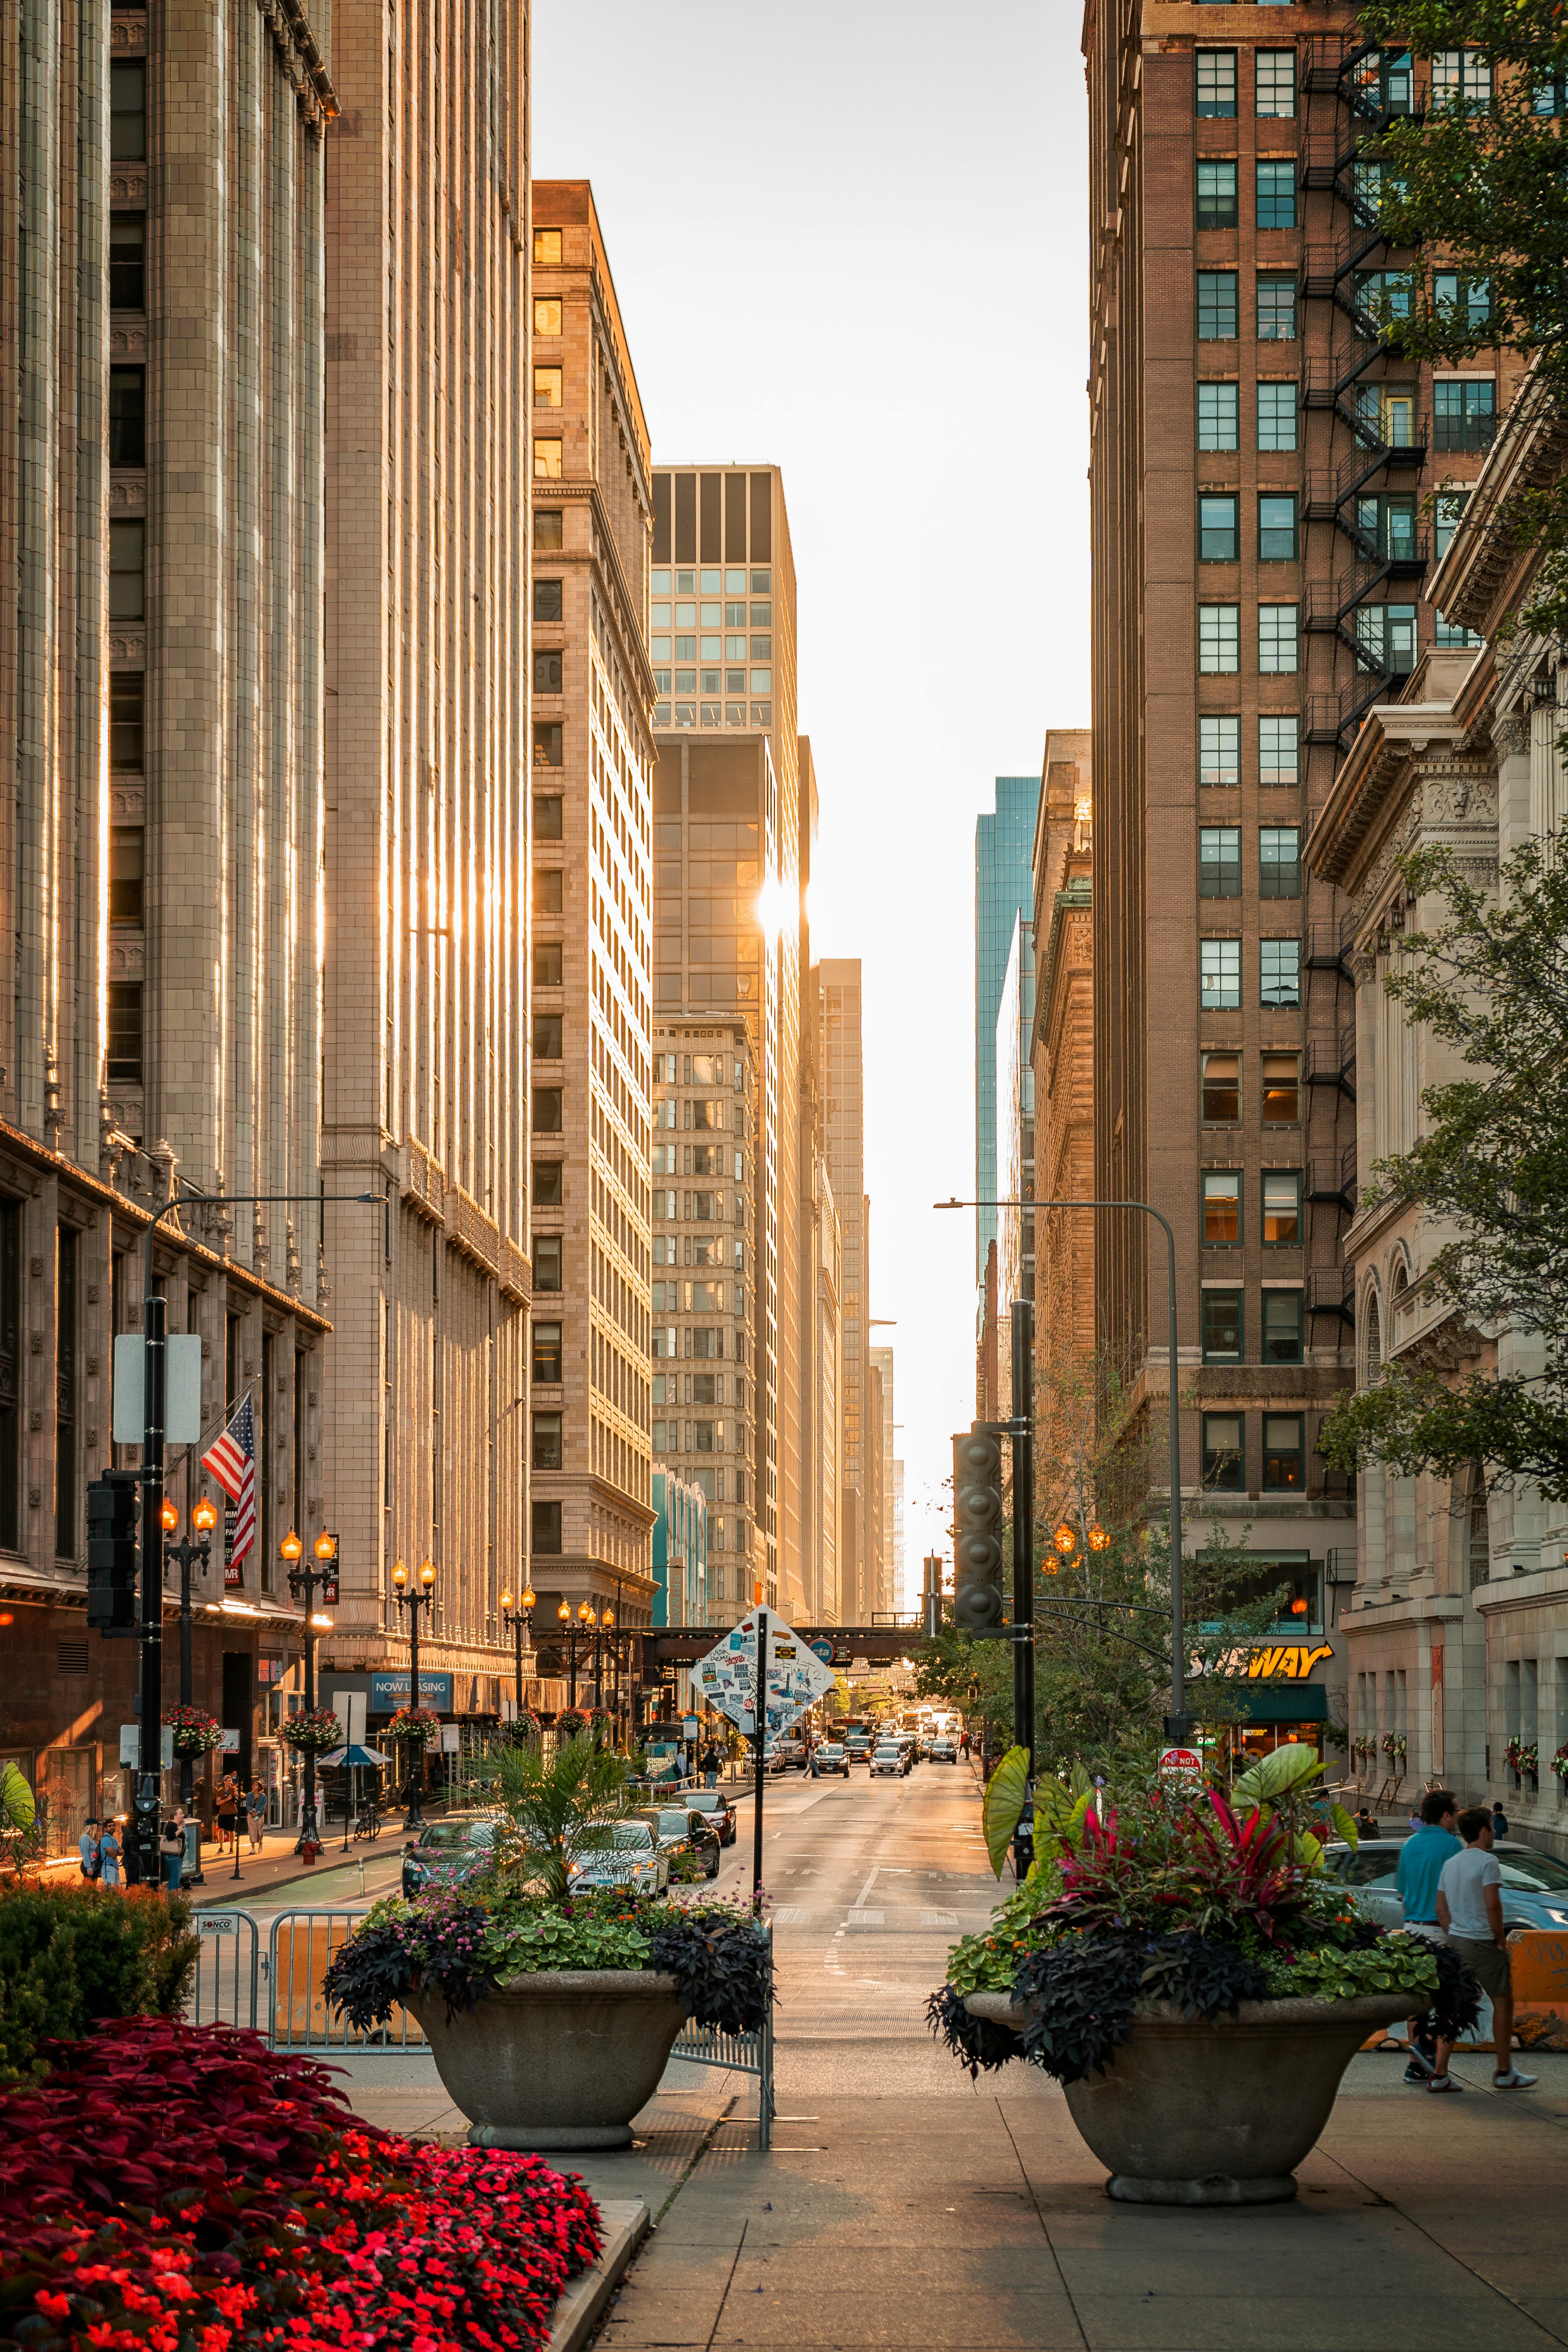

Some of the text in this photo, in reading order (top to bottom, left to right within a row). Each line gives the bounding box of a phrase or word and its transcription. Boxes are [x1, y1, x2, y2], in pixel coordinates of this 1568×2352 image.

[813, 1648, 829, 1656] cta
[1184, 1644, 1334, 1678] SUBWAY
[376, 1682, 445, 1691] NOW LASING
